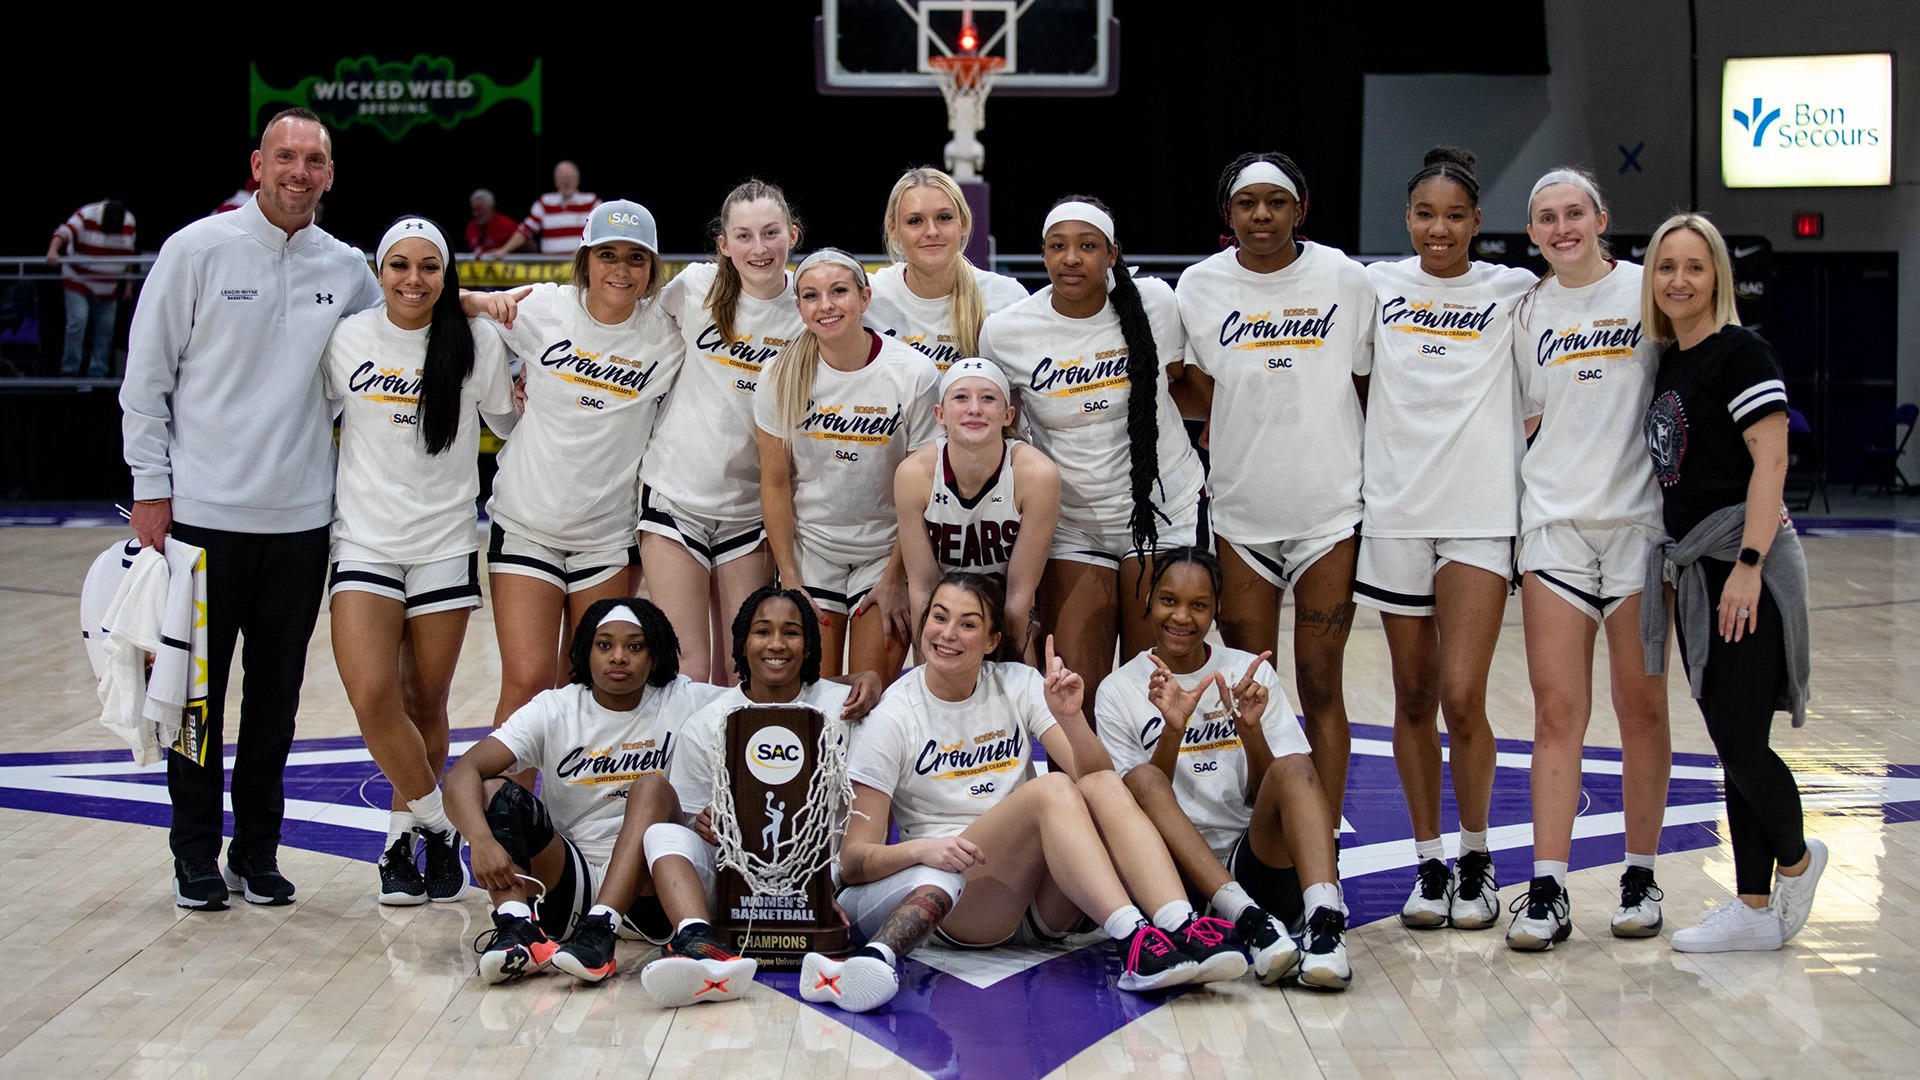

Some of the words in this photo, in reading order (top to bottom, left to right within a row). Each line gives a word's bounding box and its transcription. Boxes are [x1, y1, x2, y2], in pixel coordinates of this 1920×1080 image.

[314, 80, 404, 100] WICKED
[407, 80, 474, 99] WEED
[358, 102, 428, 115] BREWING
[1796, 103, 1844, 126] Bon
[1778, 124, 1879, 148] Secours
[611, 212, 639, 226] SAC
[1480, 240, 1507, 255] SAC
[1739, 281, 1764, 295] SAC
[1283, 308, 1318, 317] 2022-23
[1382, 295, 1497, 332] Crowned
[1219, 303, 1338, 347] Crowned
[1412, 326, 1448, 337] CONFERENCE
[696, 323, 778, 363] Crown
[1421, 344, 1447, 356] SAC
[1537, 320, 1643, 367] Crowned
[1565, 350, 1601, 361] CONFERENCE
[1601, 348, 1626, 356] CHAMPS
[540, 339, 659, 392] Crowned
[729, 359, 763, 372] CONFERENC
[1268, 358, 1293, 369] SAC
[349, 360, 426, 396] Crown
[1578, 369, 1603, 381] SAC
[574, 375, 609, 391] CONFERENCE
[609, 385, 633, 396] CHAMPS
[1068, 381, 1106, 395] CONFERENCE
[1106, 376, 1130, 387] CHAMP
[382, 394, 419, 404] CONFERENCE
[580, 395, 605, 410] SAC
[1084, 400, 1110, 413] SAC
[393, 413, 418, 426] SAC
[824, 432, 859, 442] CONFERENCE
[835, 449, 859, 462] SAC
[556, 731, 673, 778] Crowned
[757, 743, 800, 761] SAC
[914, 723, 1024, 776] Crowned
[954, 767, 989, 777] CONFERENCE
[989, 760, 1012, 771] CHAMPS
[1193, 761, 1218, 773] SAC
[594, 775, 632, 783] CONFERENCE
[970, 782, 995, 796] SAC
[740, 896, 806, 908] WOMEN'S
[731, 908, 815, 921] BASKETBALL
[737, 935, 807, 949] CHAMPIONS
[775, 957, 804, 966] Universi
